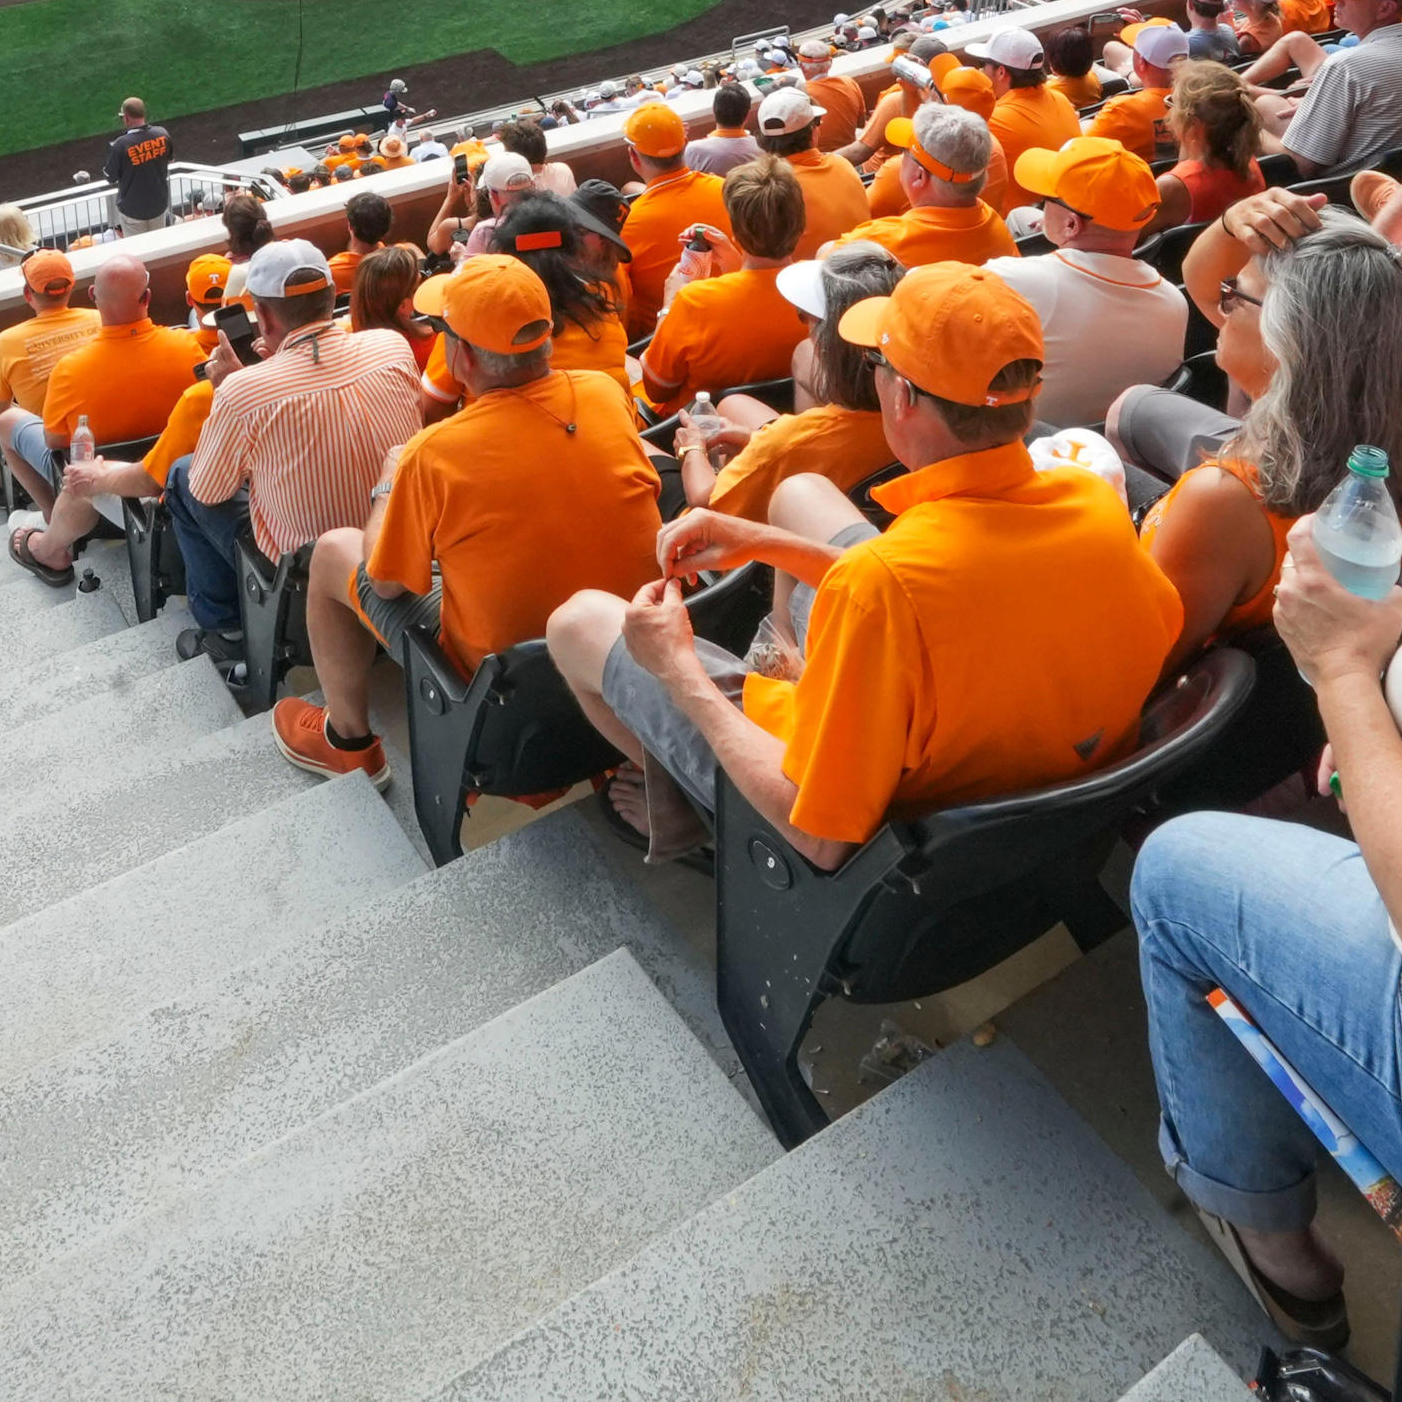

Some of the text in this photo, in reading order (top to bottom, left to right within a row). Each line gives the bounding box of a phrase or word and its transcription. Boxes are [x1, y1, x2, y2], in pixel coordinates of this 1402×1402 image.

[127, 136, 166, 158] EVENT
[131, 147, 166, 166] STAFF
[209, 274, 219, 284] T
[986, 395, 998, 406] T
